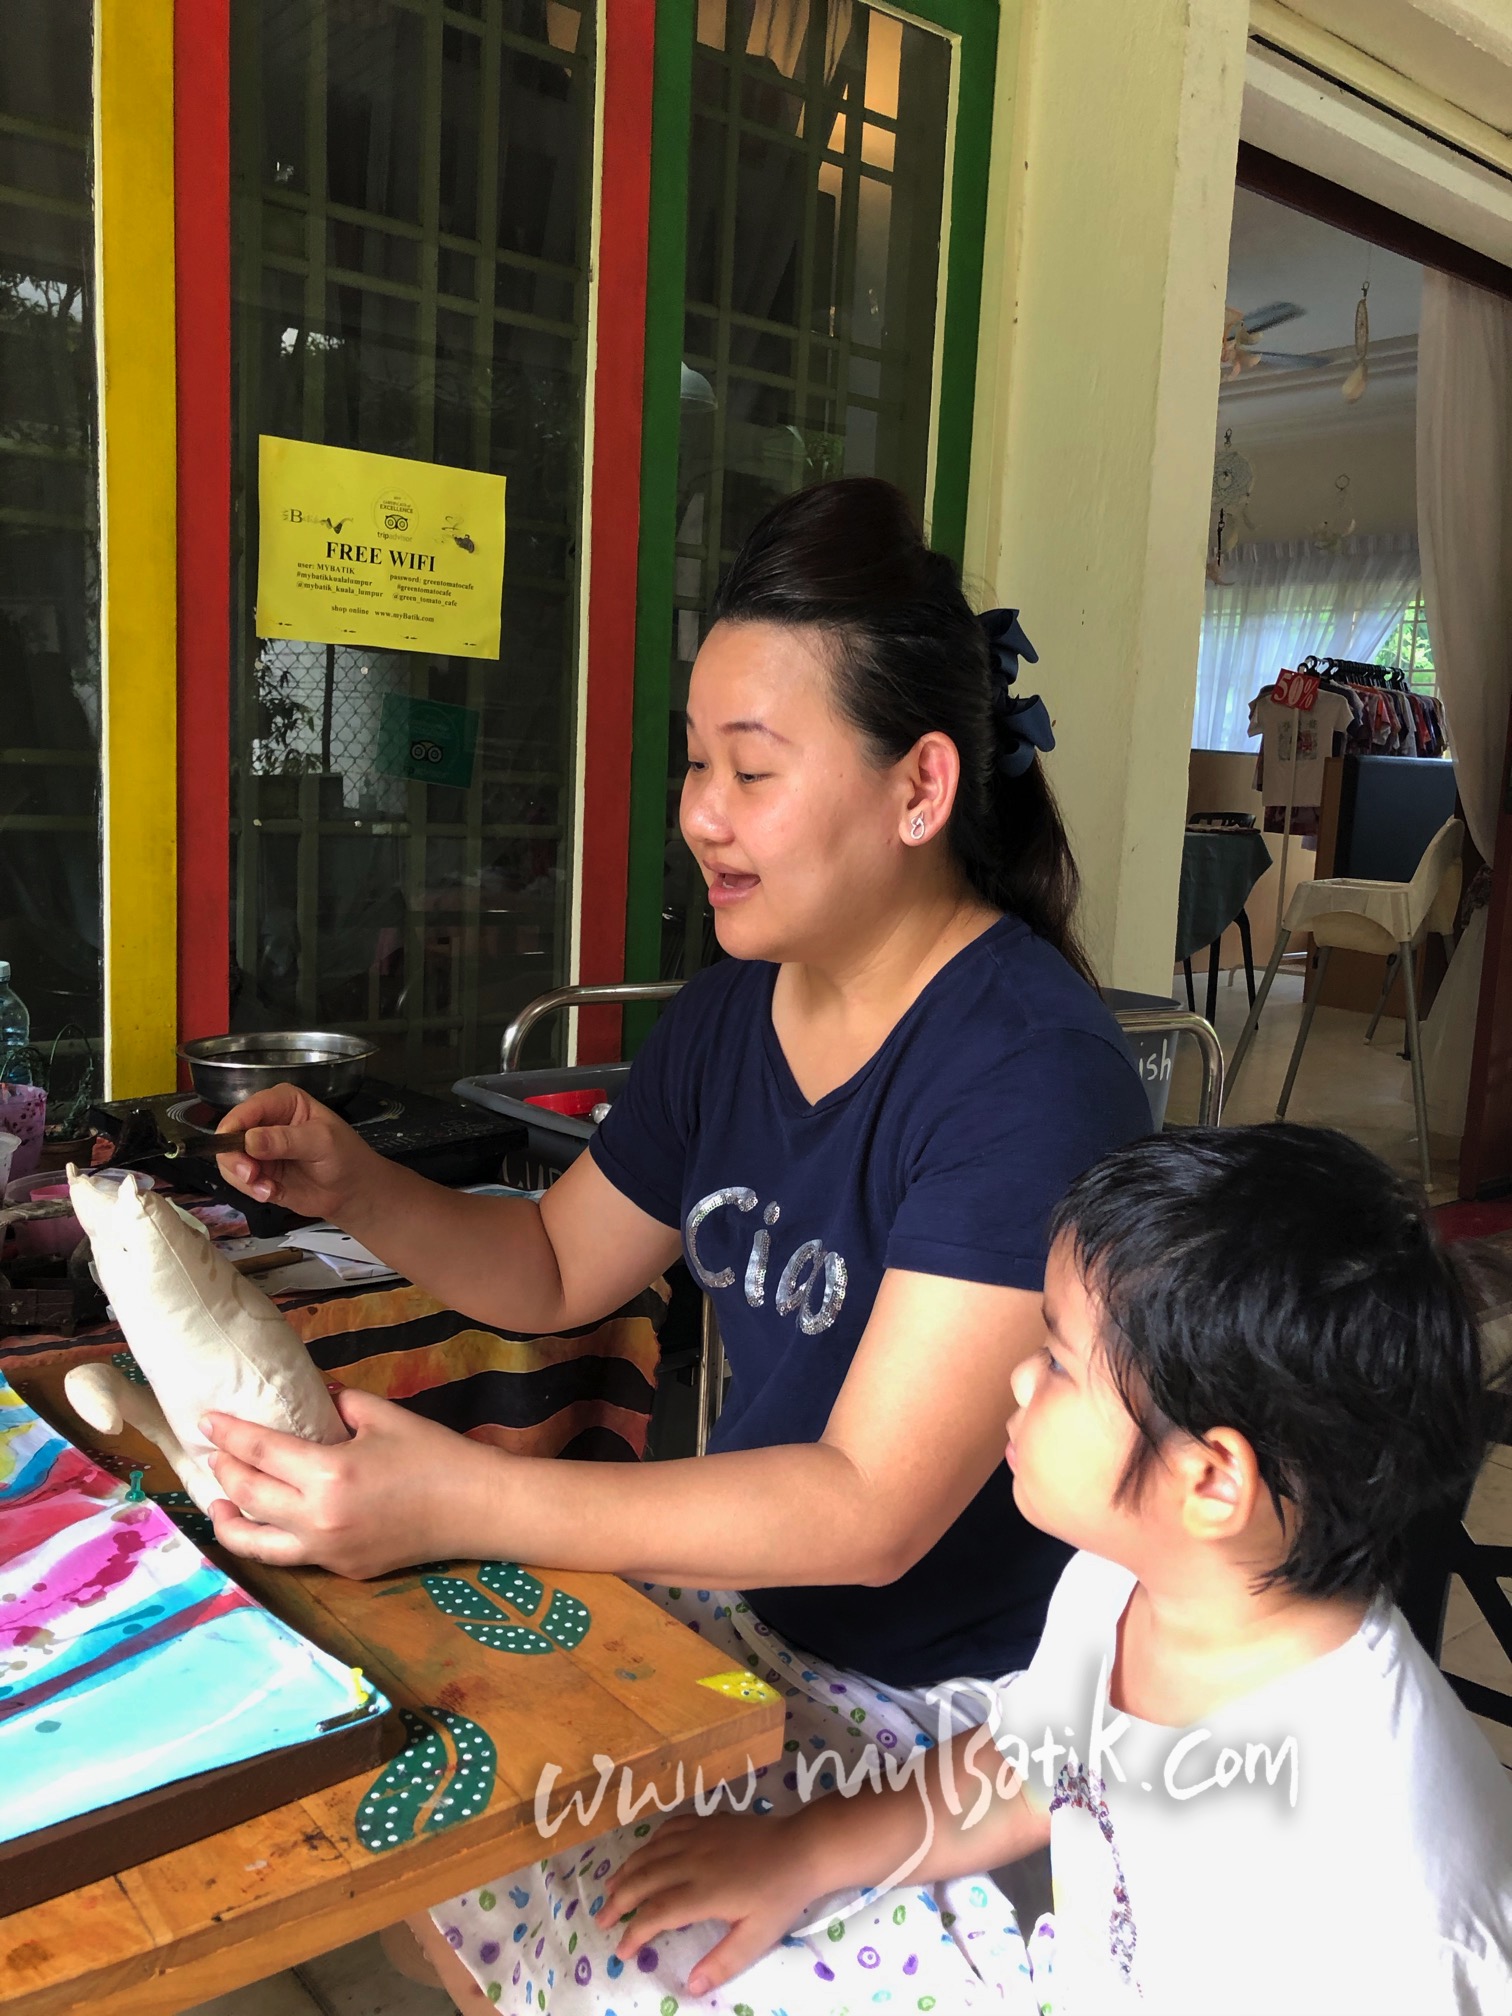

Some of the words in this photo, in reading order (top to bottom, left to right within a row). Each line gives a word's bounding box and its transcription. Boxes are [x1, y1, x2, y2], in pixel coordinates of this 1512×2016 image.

[379, 503, 414, 514] EXCELLENCE
[326, 541, 382, 565] FREE
[389, 550, 435, 572] WIFI
[297, 562, 315, 570] user:
[317, 563, 355, 575] MYBATIK
[389, 574, 421, 584] password:
[423, 578, 475, 591] greentomatocafe
[331, 604, 347, 613] shop
[348, 606, 369, 614] online
[1273, 672, 1319, 709] 50%
